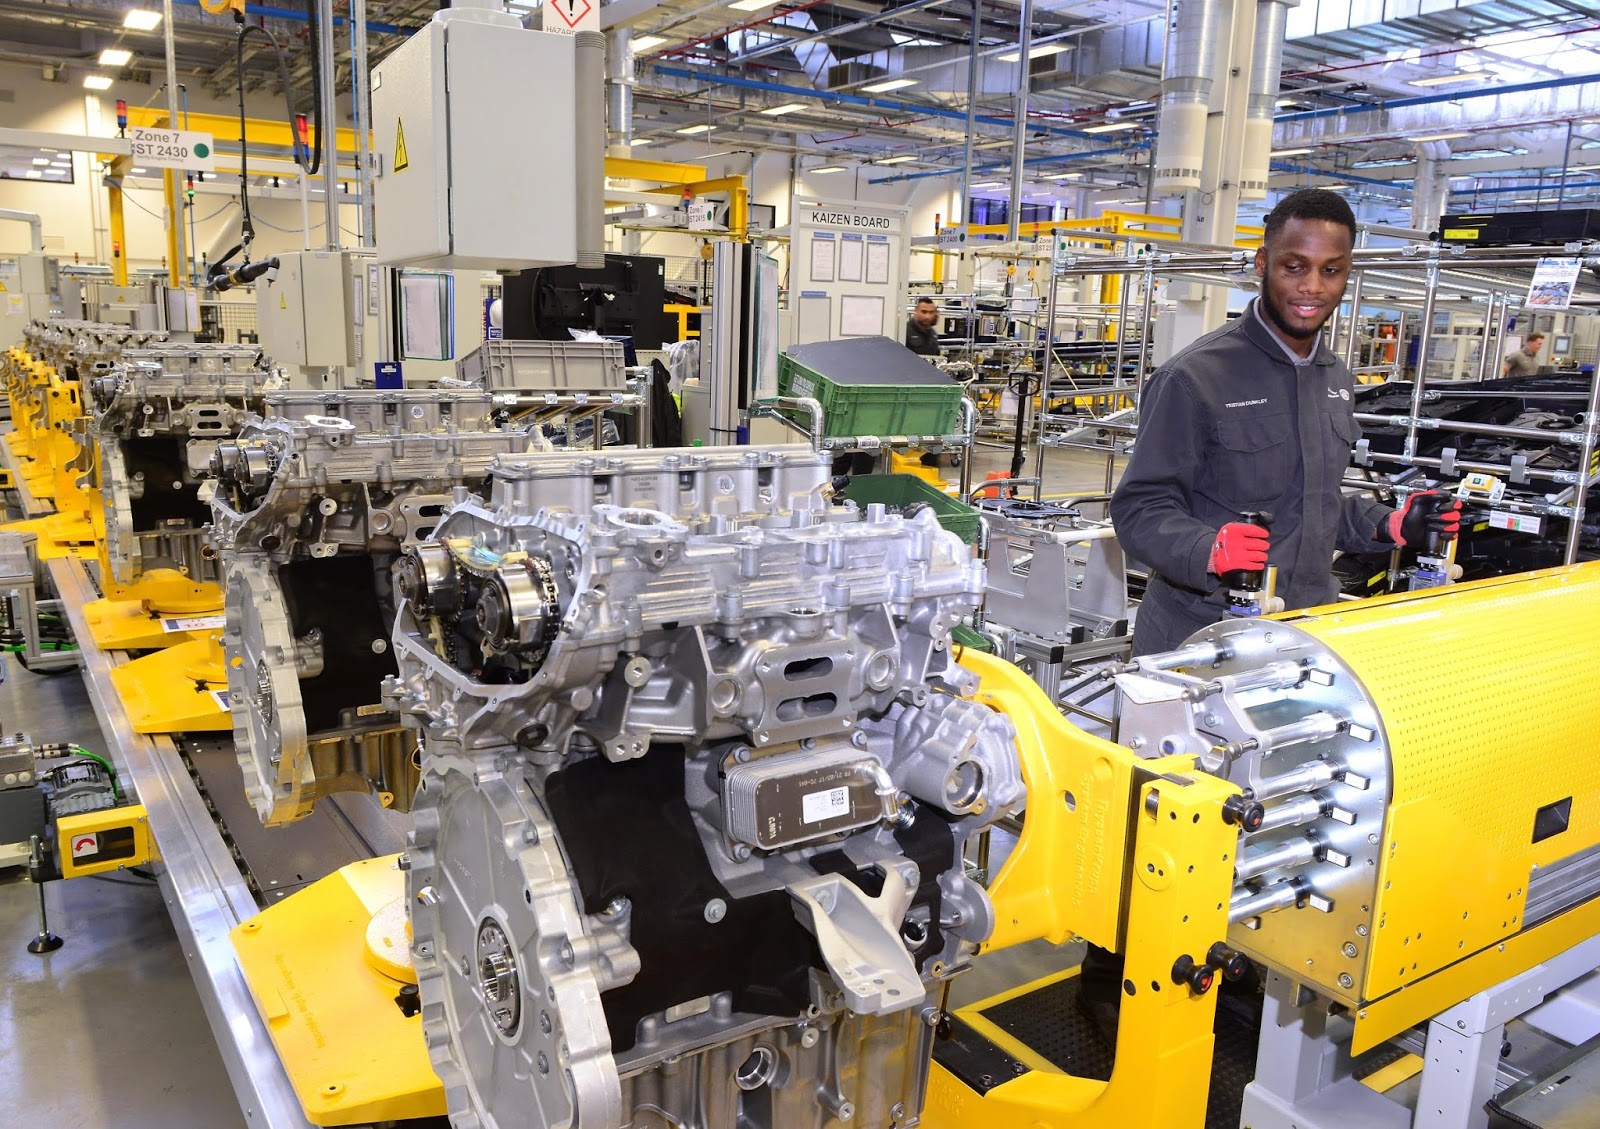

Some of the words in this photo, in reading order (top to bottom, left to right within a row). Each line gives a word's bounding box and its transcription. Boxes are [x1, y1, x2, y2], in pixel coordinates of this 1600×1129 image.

[135, 129, 170, 143] Zone
[172, 133, 180, 143] 7
[136, 143, 154, 155] ST
[157, 145, 188, 158] 2430
[690, 206, 700, 214] Zone
[689, 215, 695, 223] ST
[812, 211, 850, 225] KAIZEN
[854, 215, 890, 229] BOARD
[946, 235, 958, 243] 2400
[1039, 236, 1052, 244] Zone
[1038, 244, 1045, 252] ST
